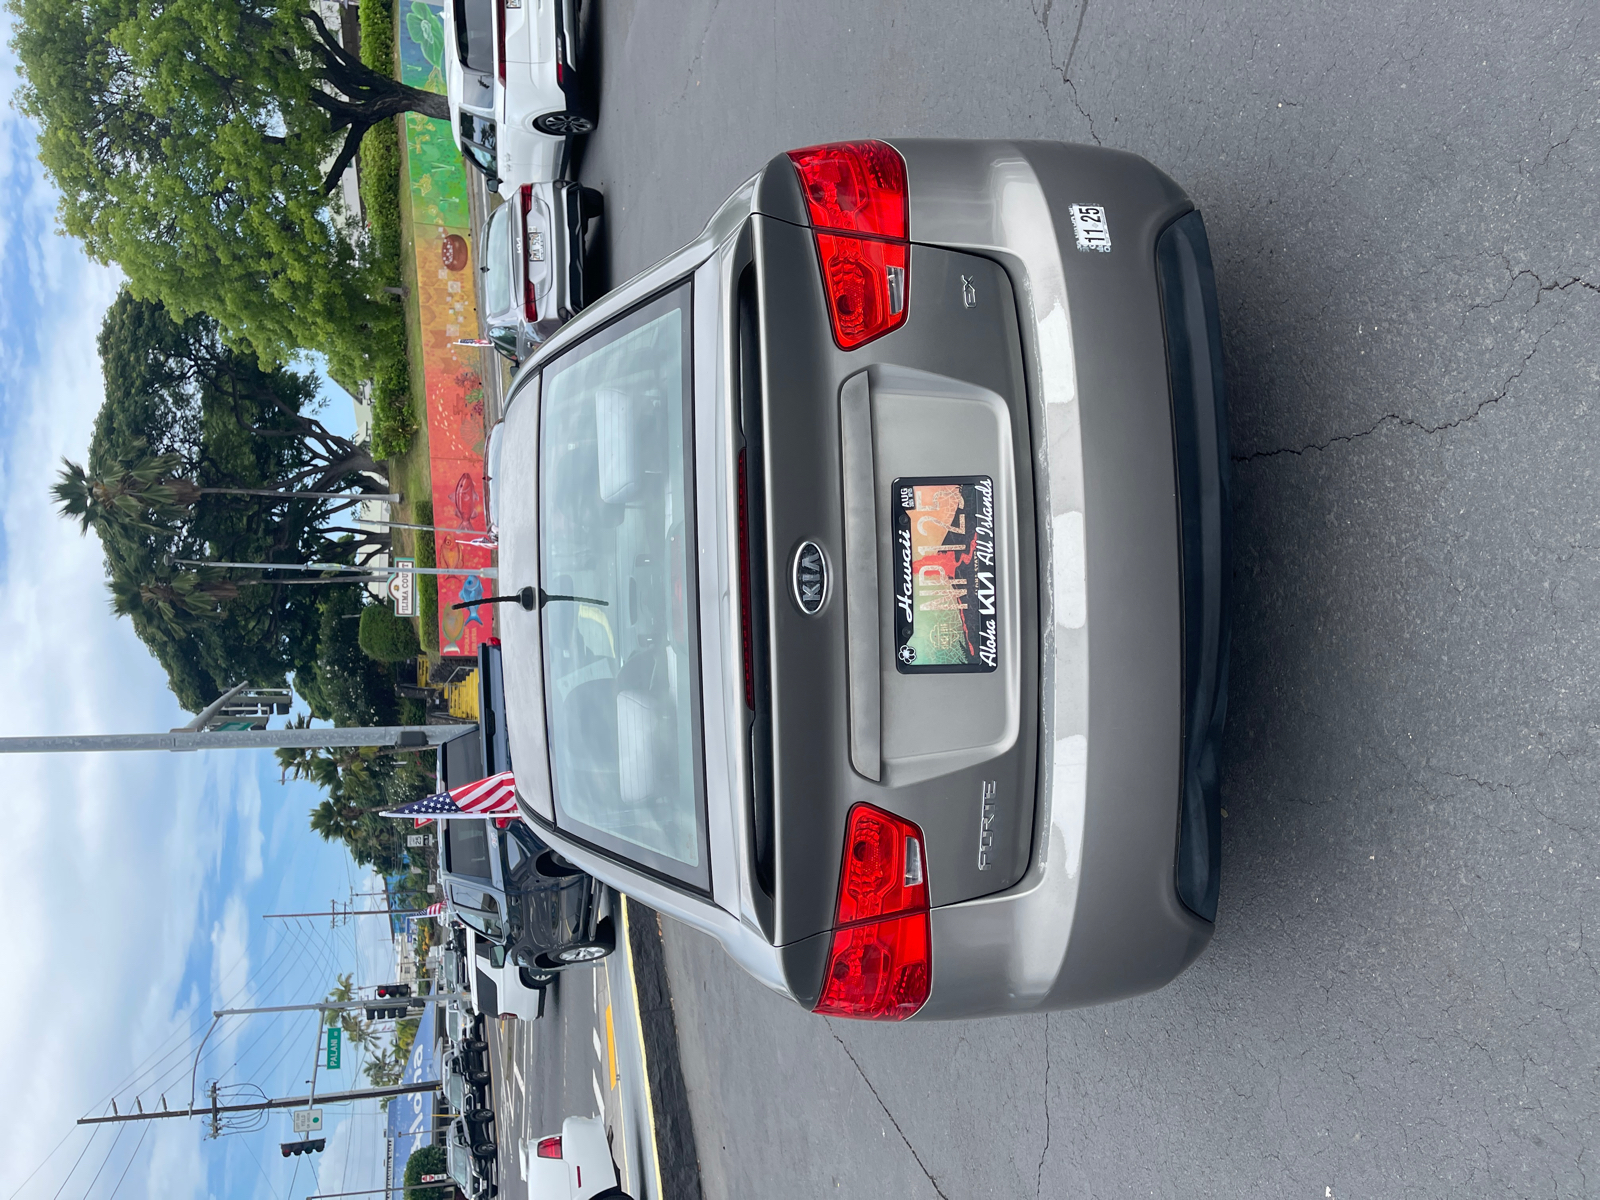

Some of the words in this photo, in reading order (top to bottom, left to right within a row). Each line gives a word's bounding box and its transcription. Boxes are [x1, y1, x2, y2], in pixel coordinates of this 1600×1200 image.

[1078, 207, 1101, 222] 25
[1083, 229, 1105, 243] 11
[961, 274, 976, 308] EX
[900, 488, 909, 507] AUG
[974, 479, 993, 537] Islands
[976, 540, 994, 566] All
[802, 552, 820, 601] KIA
[896, 529, 913, 623] Hawaii
[977, 572, 995, 615] KIA
[978, 619, 997, 666] Aloha
[415, 836, 421, 845] 25
[978, 780, 996, 870] FORTE
[330, 1039, 338, 1066] PALANI
